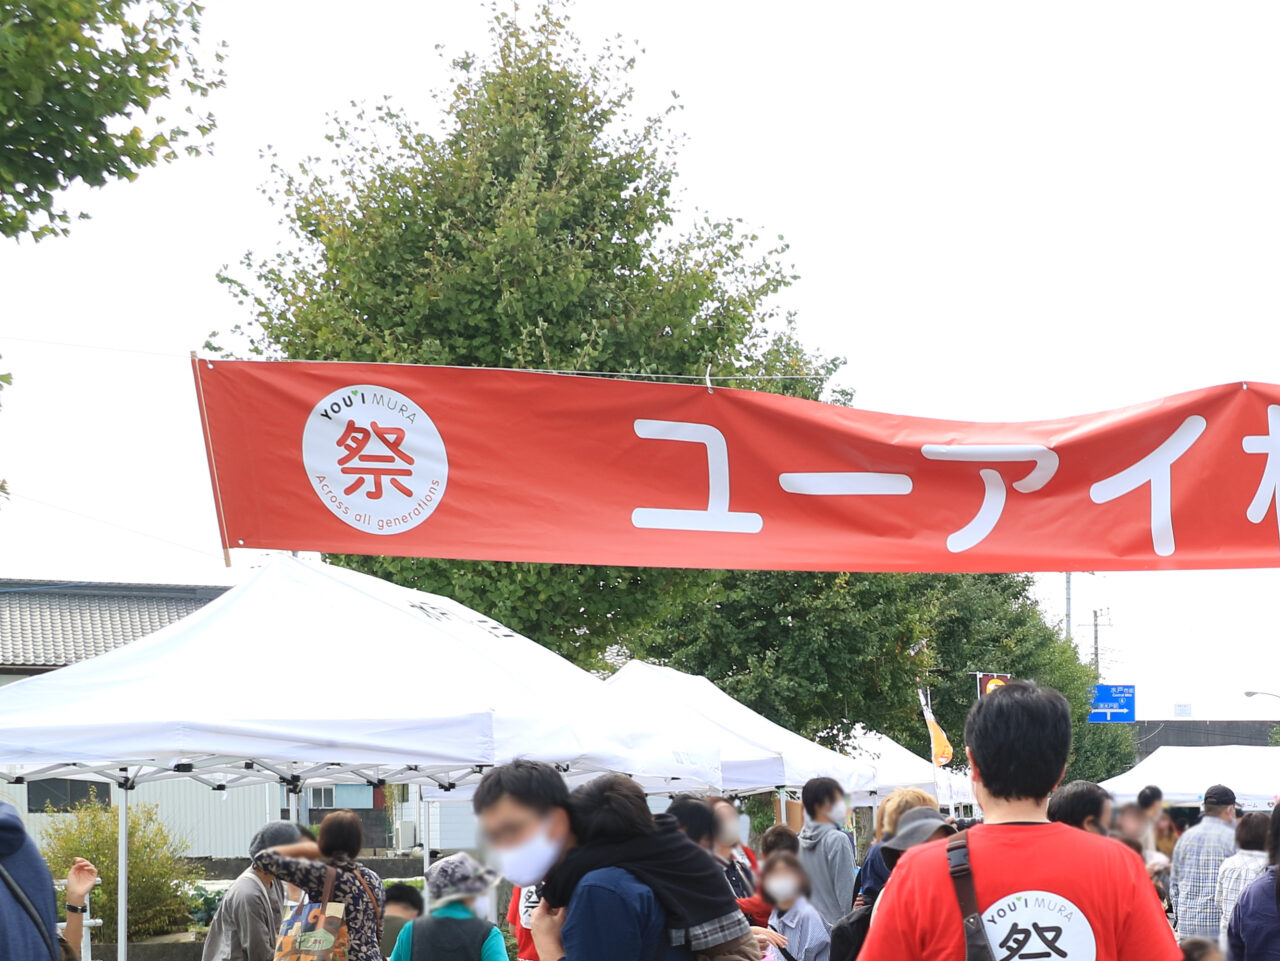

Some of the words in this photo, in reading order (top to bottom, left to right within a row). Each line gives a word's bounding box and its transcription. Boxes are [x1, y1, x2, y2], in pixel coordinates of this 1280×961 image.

[372, 392, 417, 425] MURA
[335, 419, 415, 500] 祭
[315, 474, 350, 515] Across
[354, 512, 371, 526] all
[377, 479, 440, 531] generations
[1034, 897, 1074, 922] MURA
